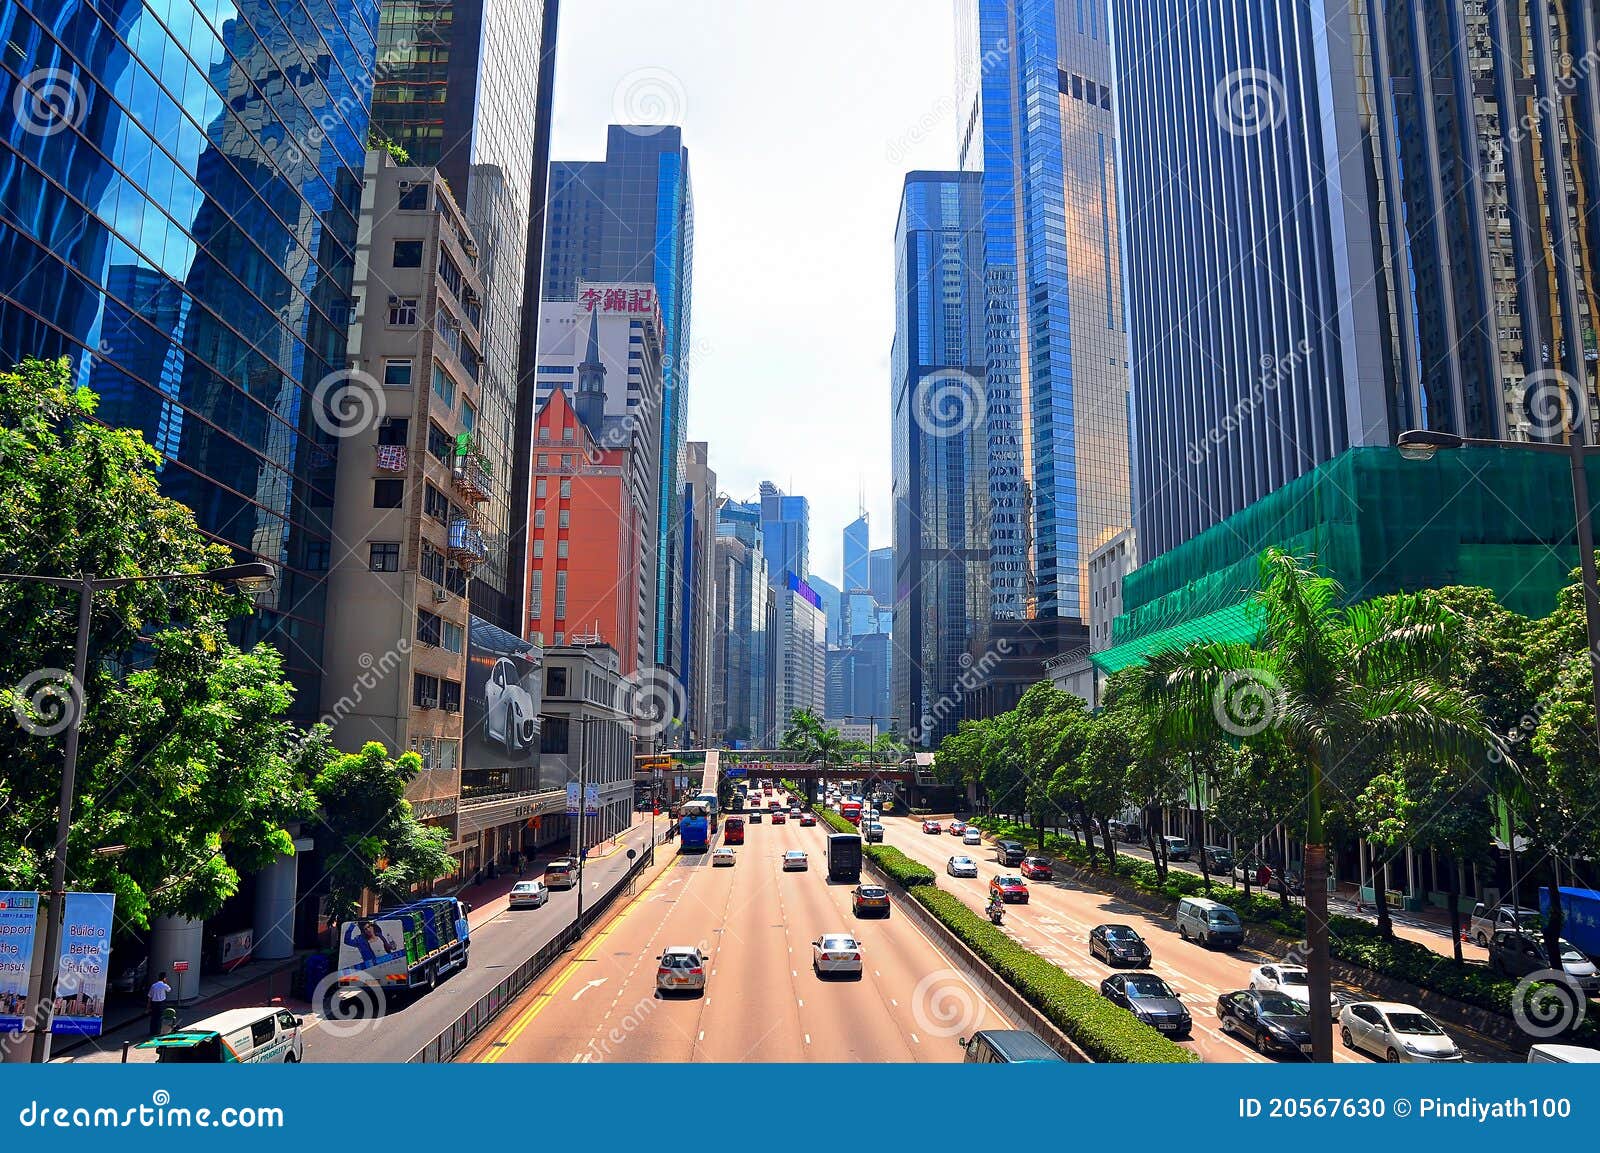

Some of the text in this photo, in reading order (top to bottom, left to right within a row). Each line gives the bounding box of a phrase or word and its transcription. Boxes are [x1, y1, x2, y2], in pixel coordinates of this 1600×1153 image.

[579, 288, 652, 312] 李錦記
[70, 925, 105, 936] Build a
[1, 943, 18, 953] the
[70, 944, 100, 954] Better
[67, 962, 100, 973] Future
